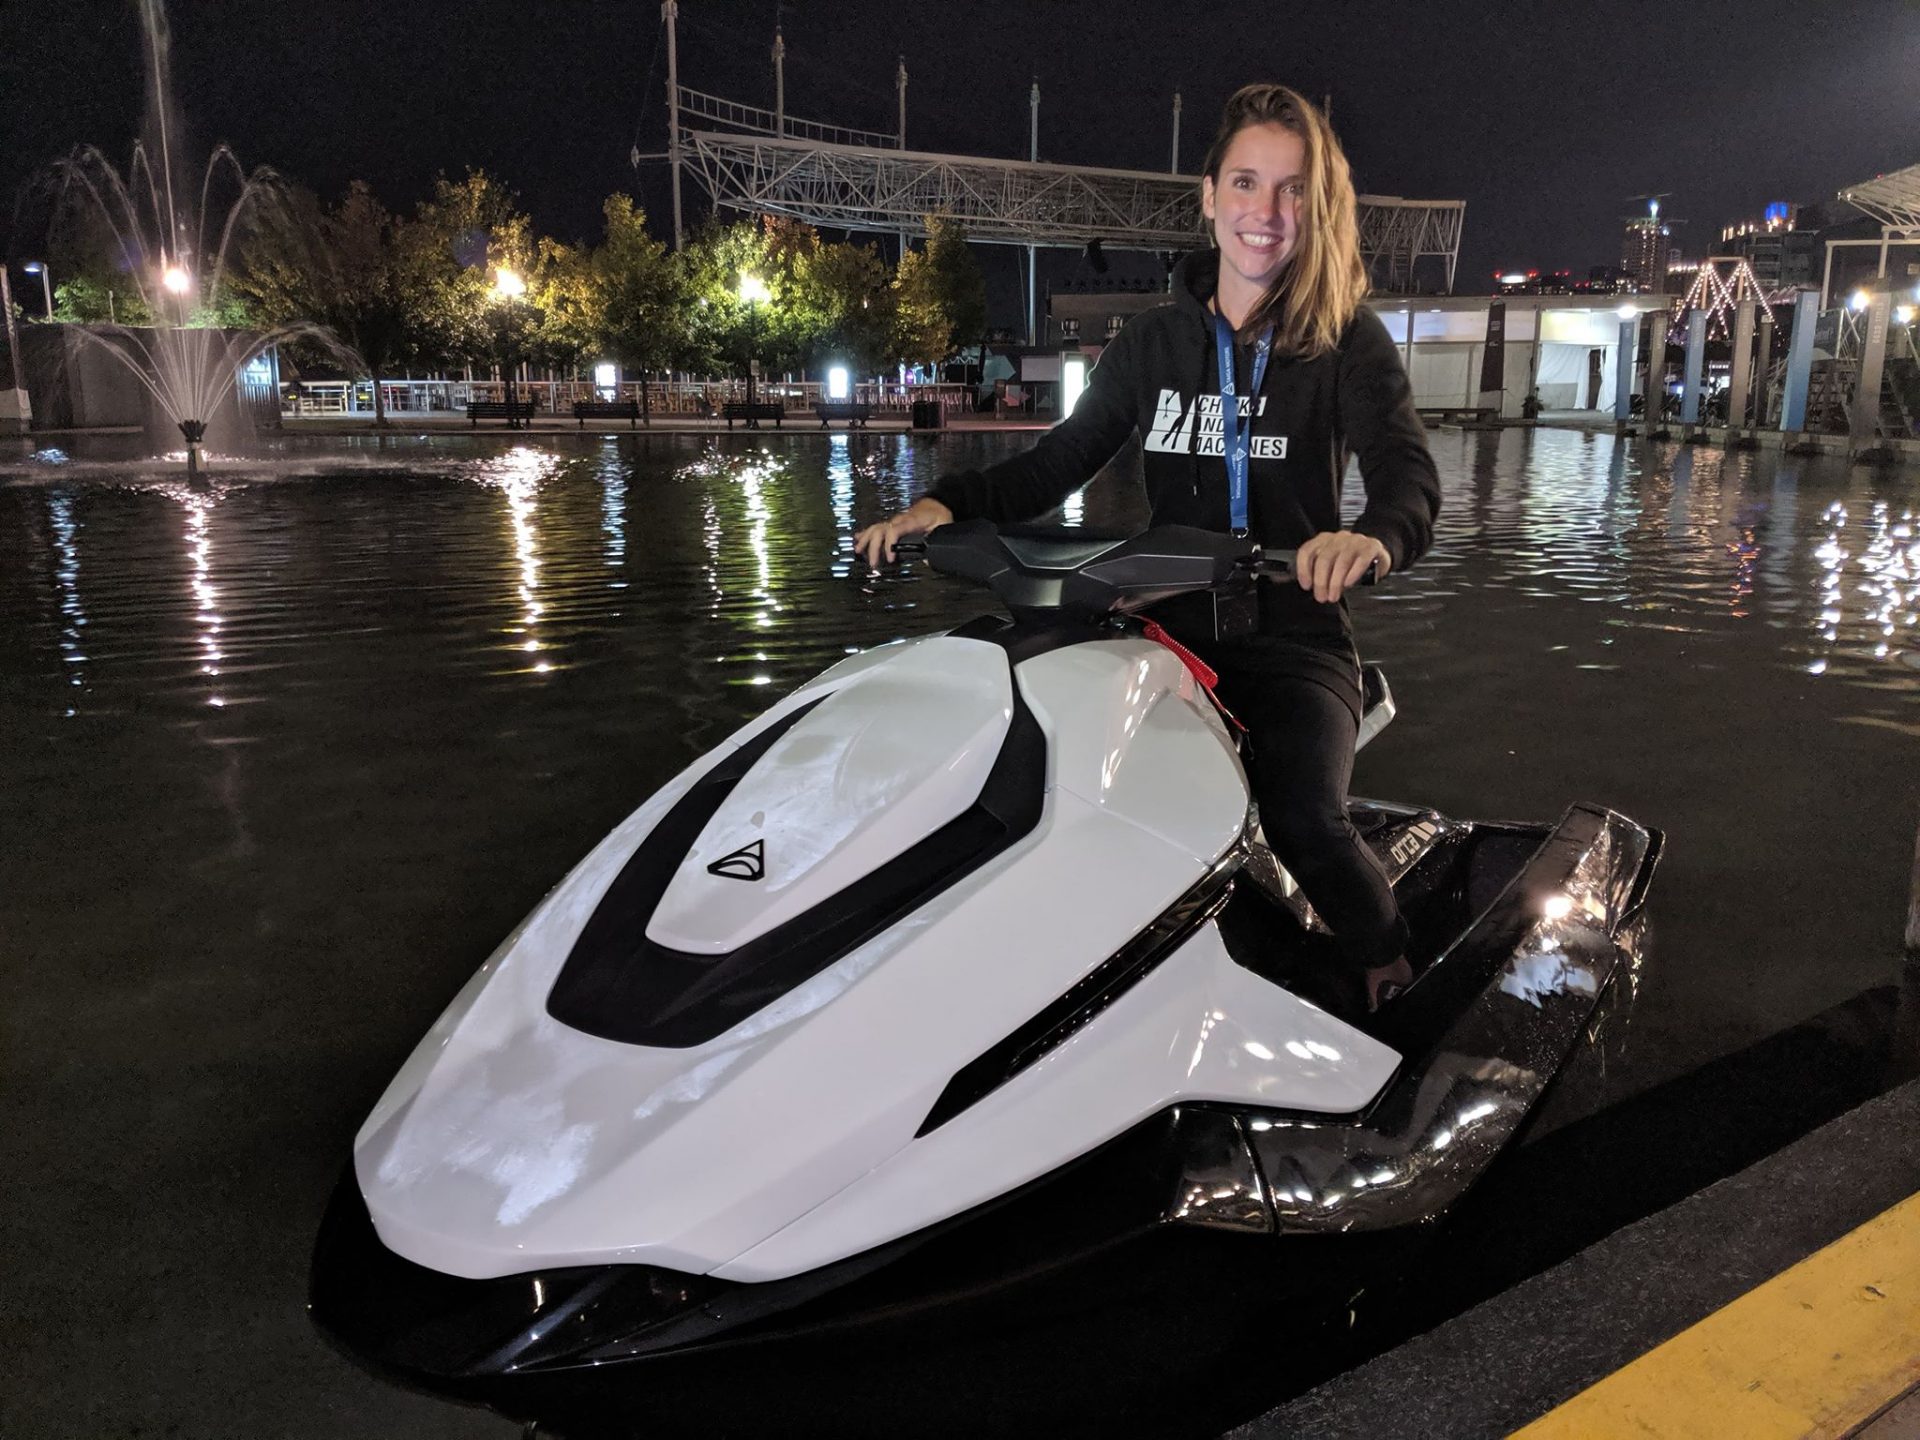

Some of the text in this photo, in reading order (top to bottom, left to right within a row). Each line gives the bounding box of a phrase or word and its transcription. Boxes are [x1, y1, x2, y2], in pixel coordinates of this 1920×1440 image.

[1199, 396, 1261, 414] CHK
[1199, 417, 1225, 433] ND
[1196, 436, 1282, 457] ACNES
